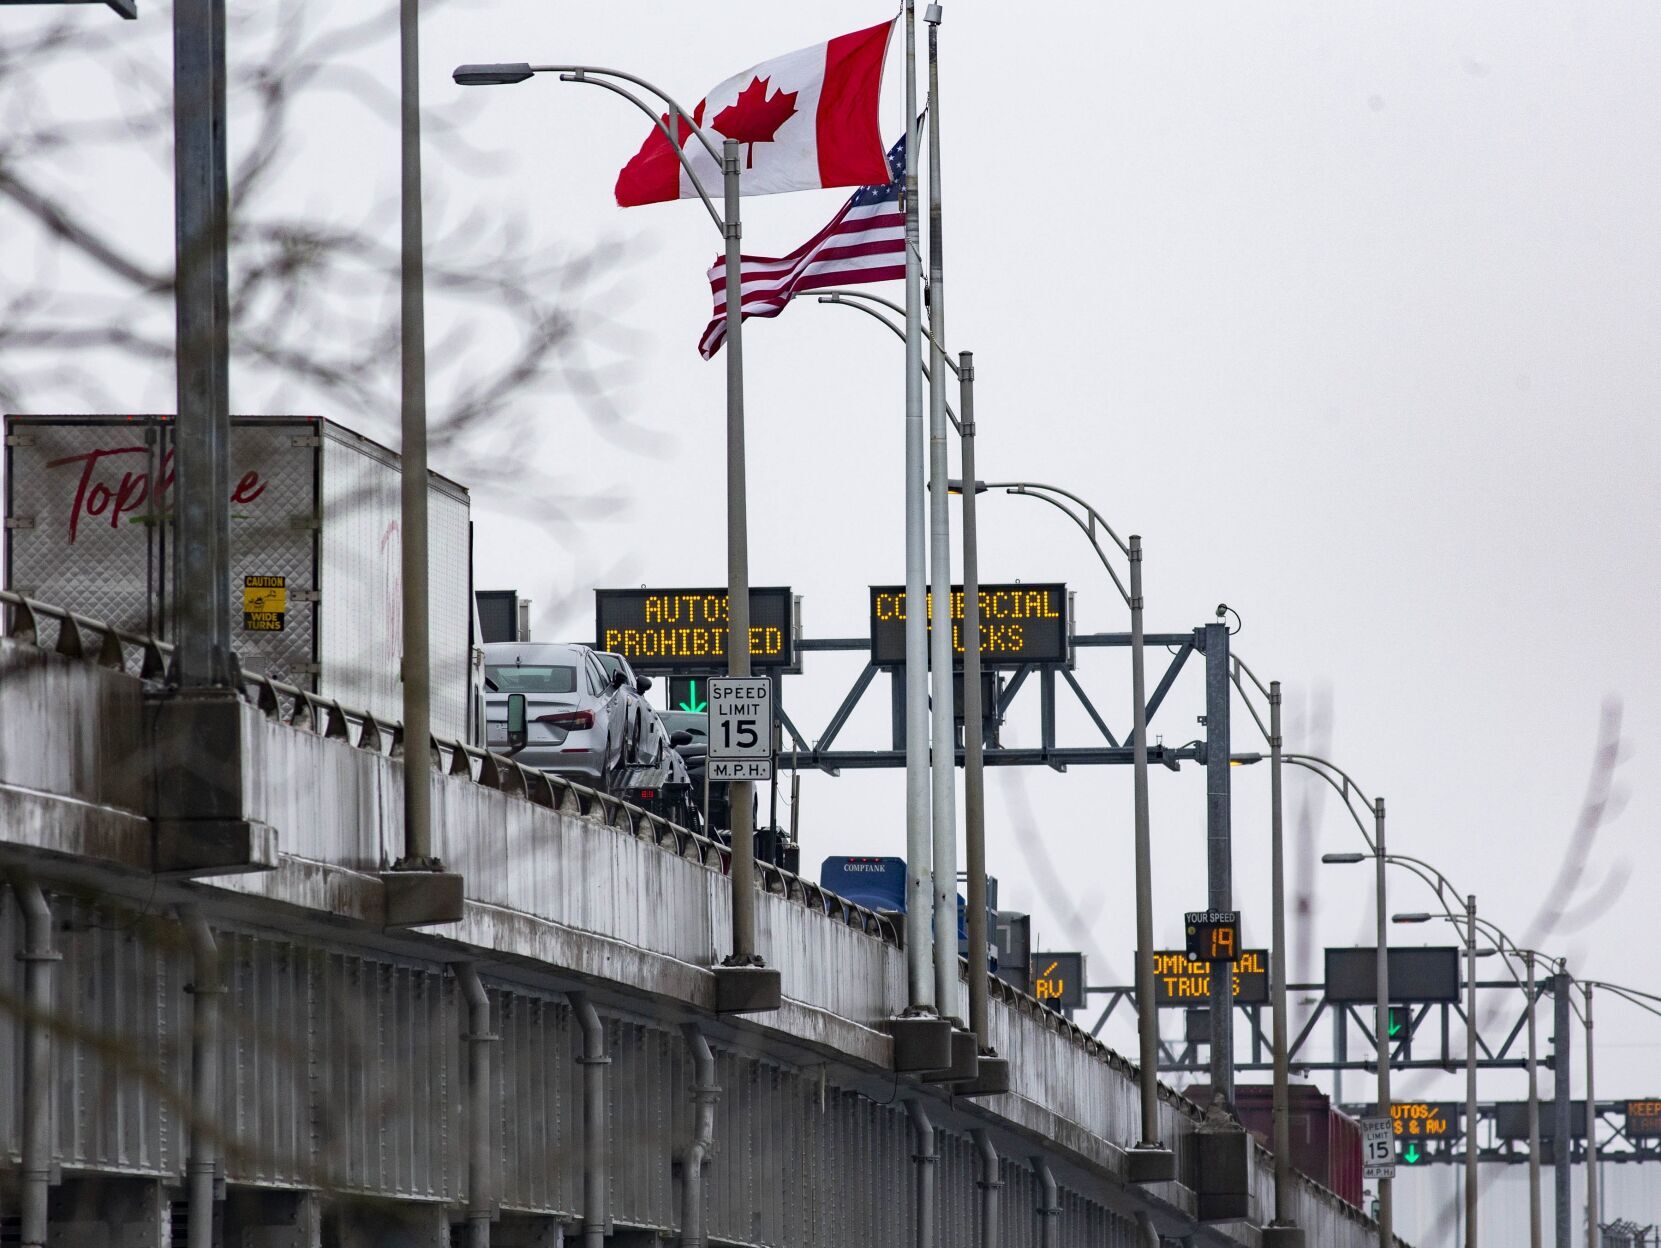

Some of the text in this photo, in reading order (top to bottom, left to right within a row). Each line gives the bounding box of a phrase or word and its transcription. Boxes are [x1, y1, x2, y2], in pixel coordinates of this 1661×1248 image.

[246, 577, 284, 587] CAUTION
[251, 612, 278, 621] WIDE
[247, 621, 281, 630] TURNS
[606, 627, 781, 656] PROHIBIED
[713, 687, 767, 699] SPEED
[719, 703, 760, 715] LIMIT
[721, 720, 758, 748] 15
[716, 764, 763, 776] M.P.H.
[843, 864, 886, 872] COMPTANK
[1186, 912, 1235, 923] YOUR SPEED
[1212, 928, 1233, 957] 19
[1163, 977, 1240, 996] TRUCS
[1390, 1104, 1439, 1119] UTOS/
[1363, 1119, 1391, 1131] SPEED
[1367, 1132, 1389, 1141] LIMIT
[1369, 1141, 1389, 1159] 15
